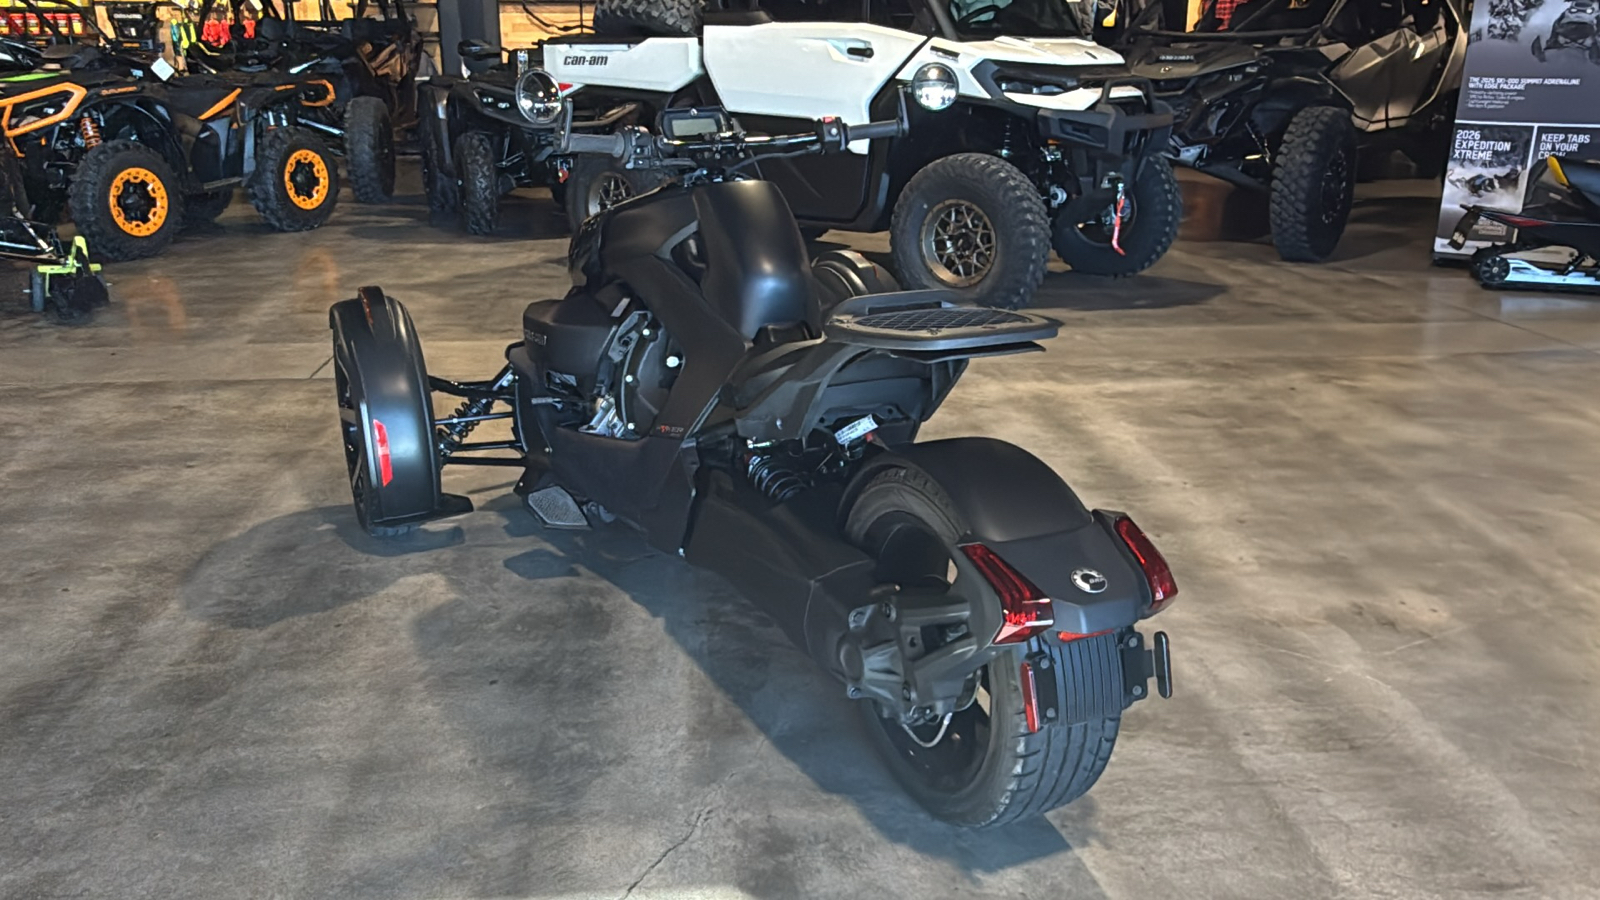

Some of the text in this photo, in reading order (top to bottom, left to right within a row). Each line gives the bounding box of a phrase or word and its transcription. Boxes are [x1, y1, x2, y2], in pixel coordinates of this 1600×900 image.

[563, 55, 609, 66] can-am
[1456, 130, 1480, 140] 2026
[1541, 134, 1590, 144] KEEP TABS
[1455, 140, 1511, 151] EXPEDITION
[1540, 141, 1579, 152] ON YOUR
[1453, 150, 1493, 160] XTREME
